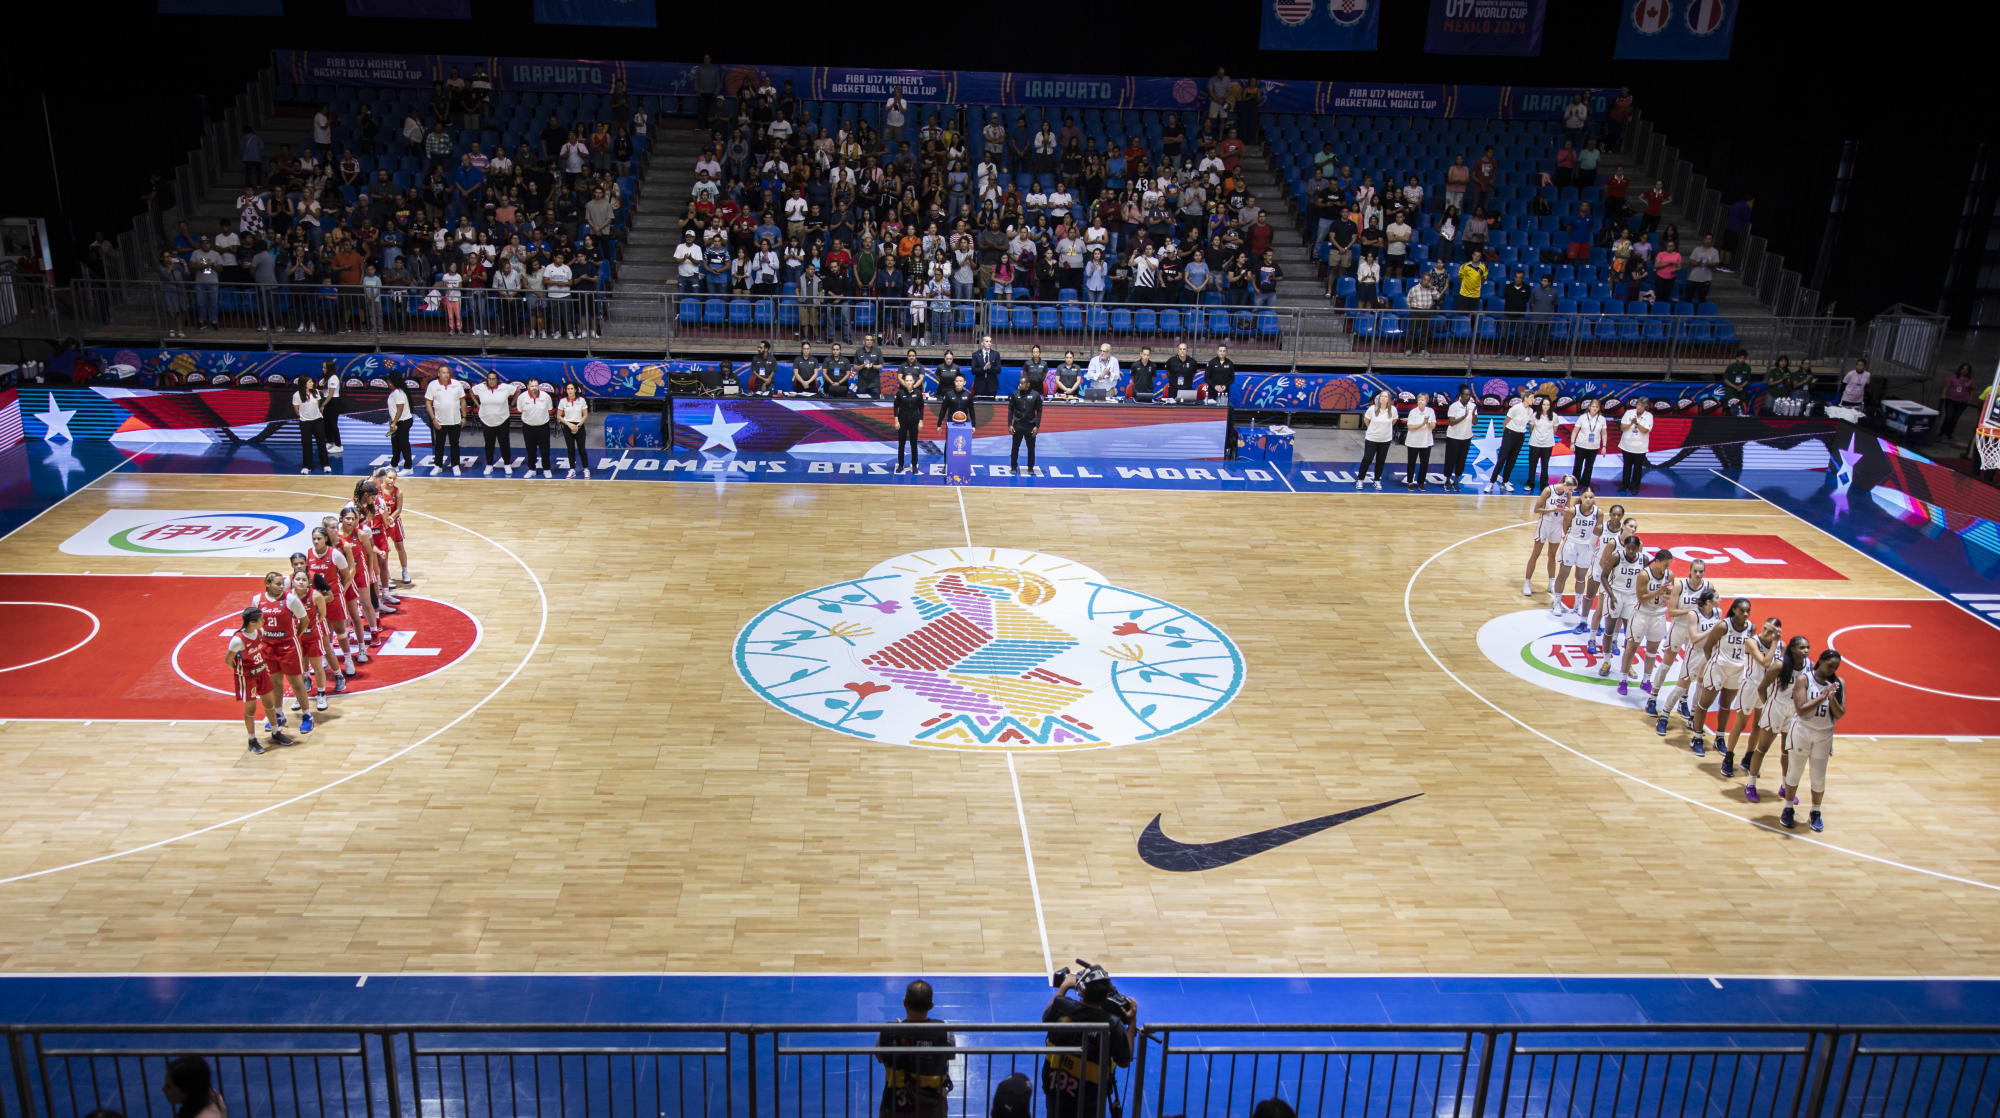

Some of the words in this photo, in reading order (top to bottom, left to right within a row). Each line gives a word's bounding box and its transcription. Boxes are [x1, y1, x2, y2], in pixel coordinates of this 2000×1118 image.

[1475, 7, 1507, 18] WORLD
[1509, 8, 1528, 18] CUP
[313, 67, 369, 78] BASKETBALL
[372, 70, 404, 80] WORLD
[406, 72, 422, 80] CUP
[513, 65, 602, 84] IRAPUATO
[845, 74, 865, 82] FIBA
[867, 75, 882, 83] U17
[885, 75, 924, 85] WOMEN'S
[832, 83, 886, 94] BASKETBALL
[922, 86, 936, 96] CUP
[1024, 80, 1111, 99] IRAPUATO
[1349, 89, 1368, 98] FIBA
[1370, 89, 1385, 98] U17
[1387, 90, 1424, 100] WOMEN'S
[1335, 98, 1388, 109] BASKETBALL
[1390, 100, 1420, 109] WORLD
[1421, 101, 1437, 110] CUP
[1136, 179, 1148, 191] 43
[597, 458, 787, 473] WOMEN'S
[1115, 466, 1275, 481] WORLD
[1575, 519, 1594, 527] USA
[138, 524, 278, 541] 伊利
[1580, 529, 1586, 538] 5
[1625, 578, 1632, 588] 8
[1650, 584, 1662, 592] US
[1684, 597, 1698, 605] US
[267, 617, 278, 627] 21
[1701, 624, 1714, 632] US
[1732, 648, 1742, 660] 12
[1815, 705, 1827, 717] 15
